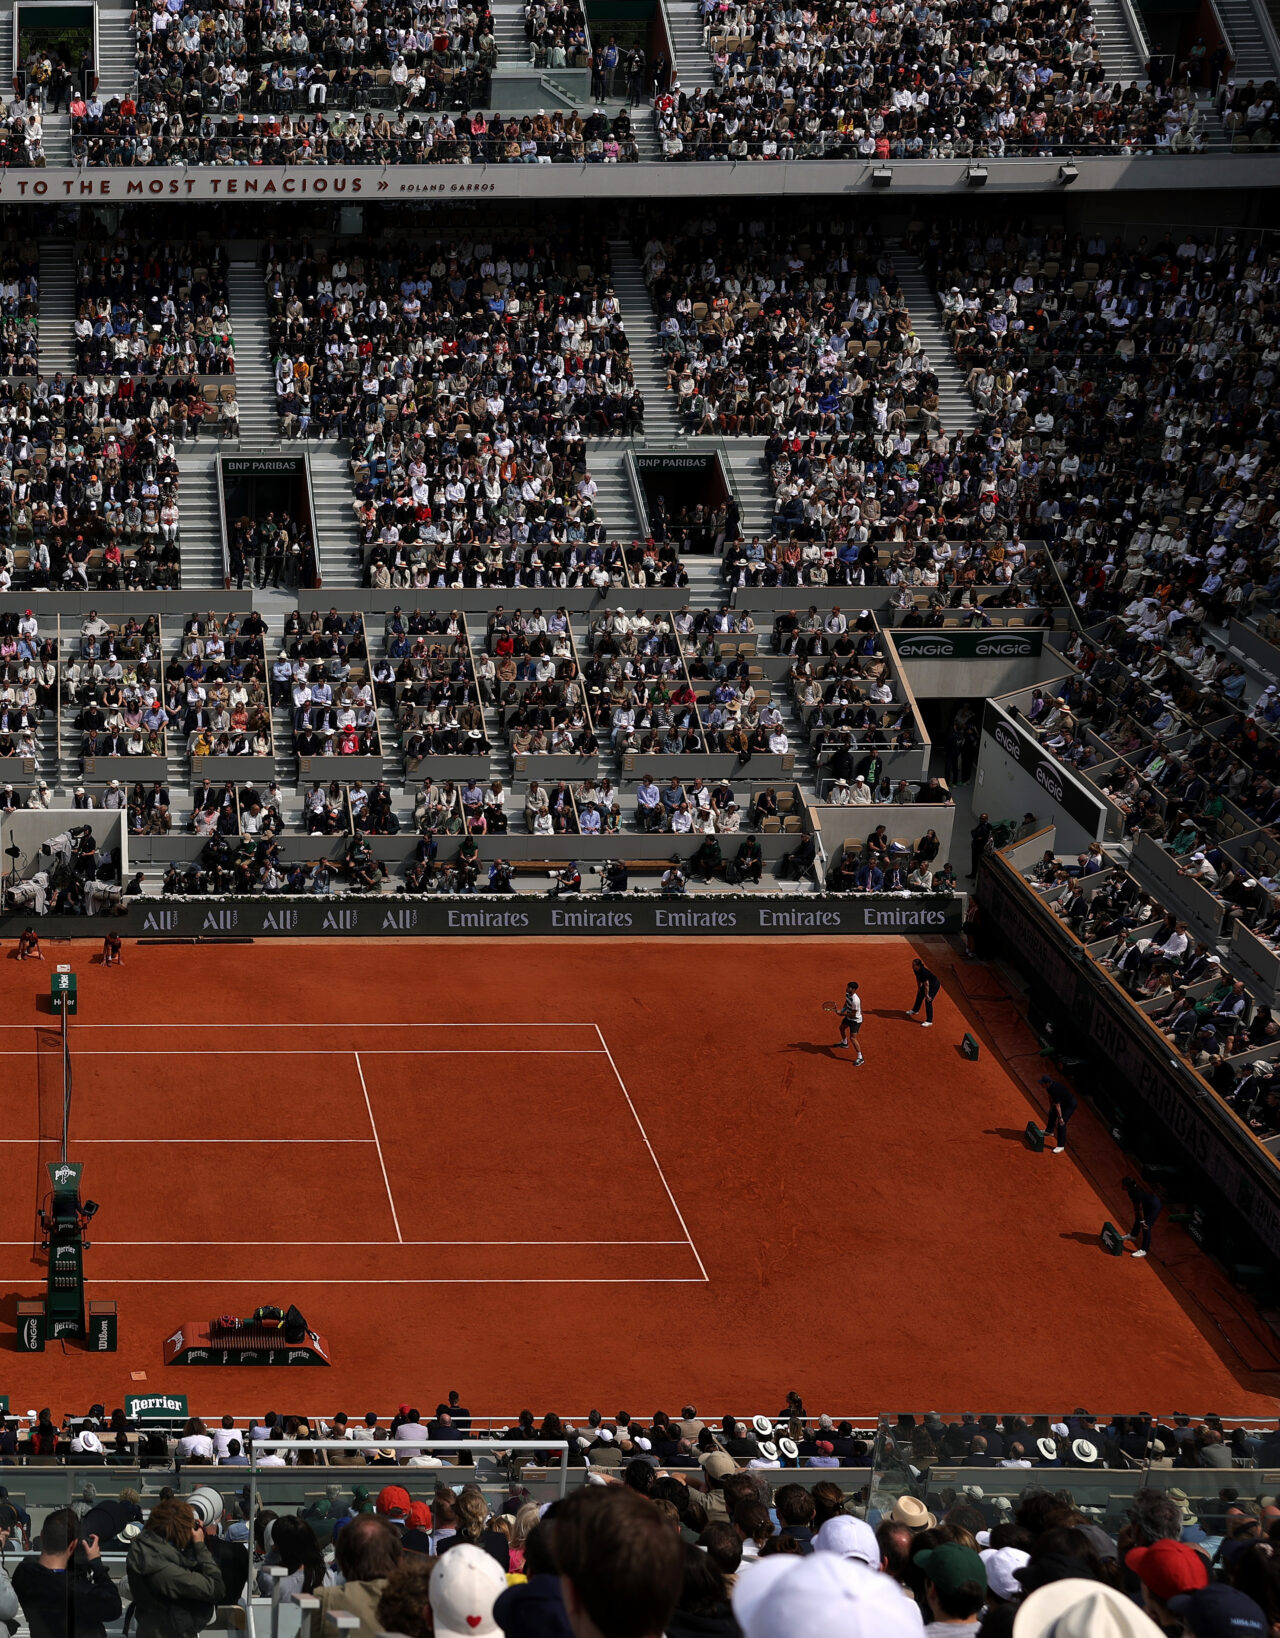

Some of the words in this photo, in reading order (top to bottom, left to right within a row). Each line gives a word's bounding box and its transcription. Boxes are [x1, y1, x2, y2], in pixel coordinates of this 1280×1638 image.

[18, 181, 49, 196] TO
[64, 180, 113, 196] THE
[127, 179, 196, 195] MOST
[210, 178, 363, 194] TENACIOUS
[400, 184, 445, 192] ROLAND
[451, 183, 495, 192] GARROS
[228, 462, 249, 470] BNP
[252, 462, 296, 470] PARIBAS
[639, 459, 660, 467] BNP
[663, 459, 706, 467] PARIBAS
[447, 909, 529, 927] Emirates
[551, 909, 633, 927] Emirates
[655, 909, 737, 927] Emirates
[759, 908, 841, 926] Emirates
[863, 907, 945, 925] Emirates
[98, 1320, 108, 1350] Wilson
